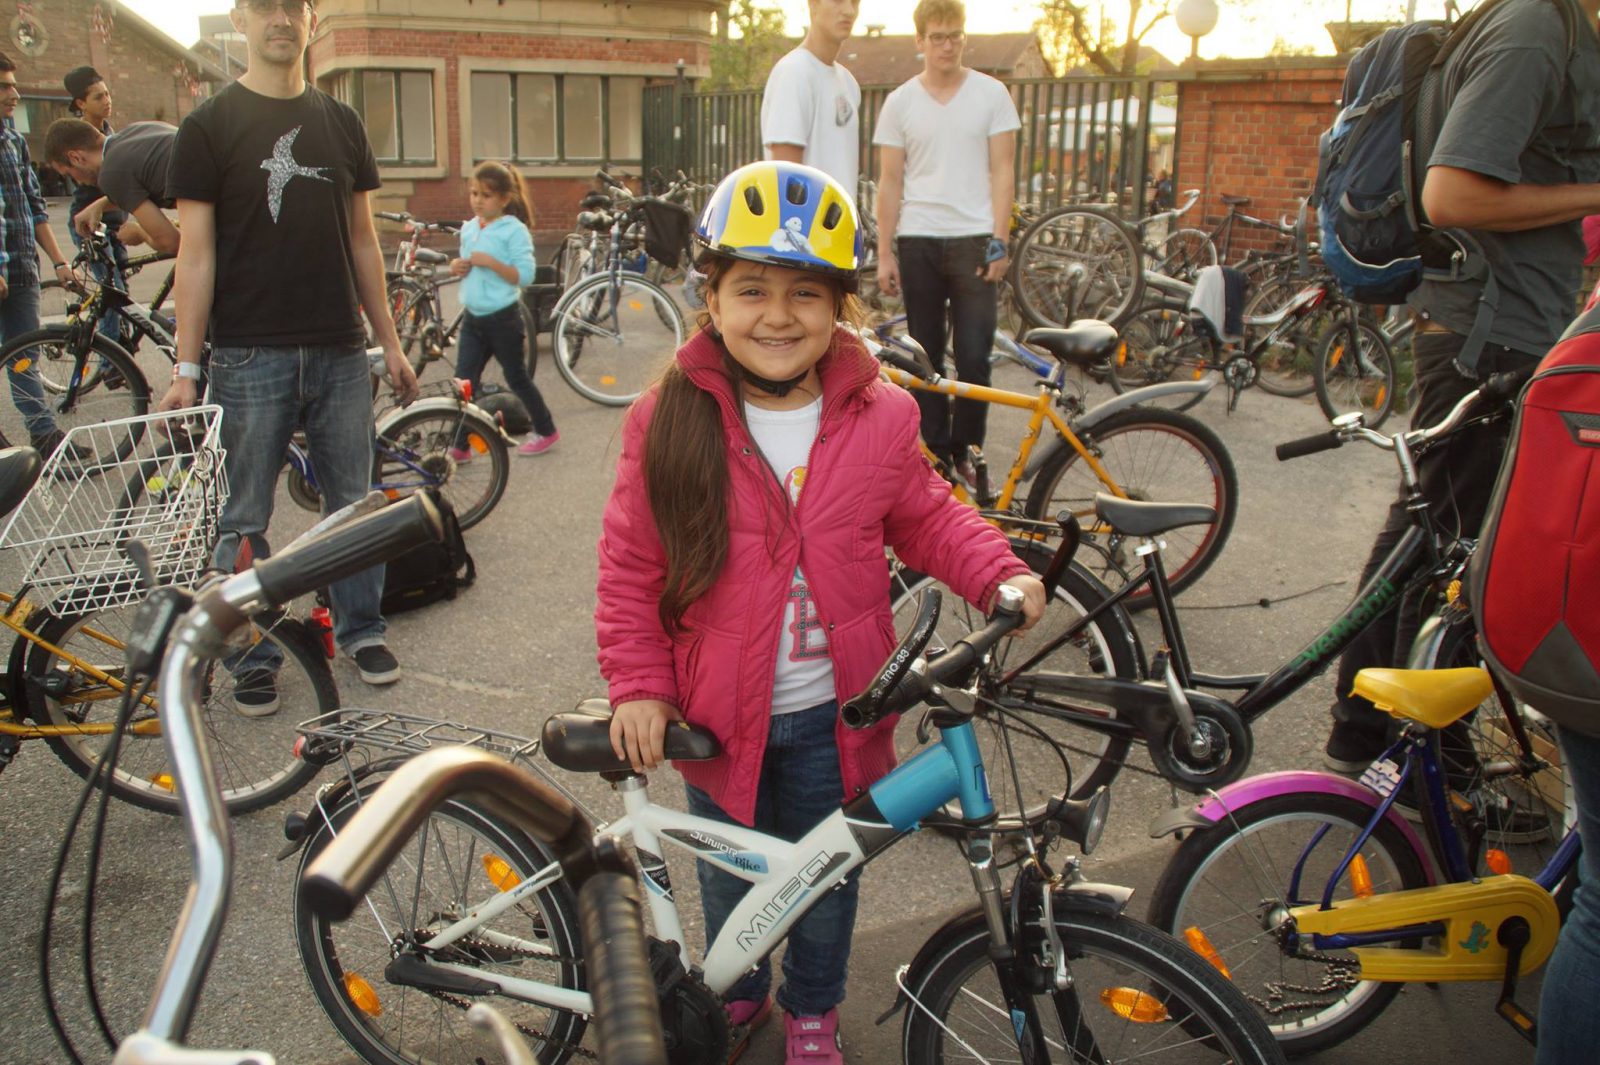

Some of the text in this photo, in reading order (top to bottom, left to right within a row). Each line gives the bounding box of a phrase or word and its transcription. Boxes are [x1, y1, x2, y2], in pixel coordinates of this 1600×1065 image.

[690, 831, 738, 857] JUNIOR
[734, 856, 761, 872] Bike
[736, 850, 832, 953] MIFA
